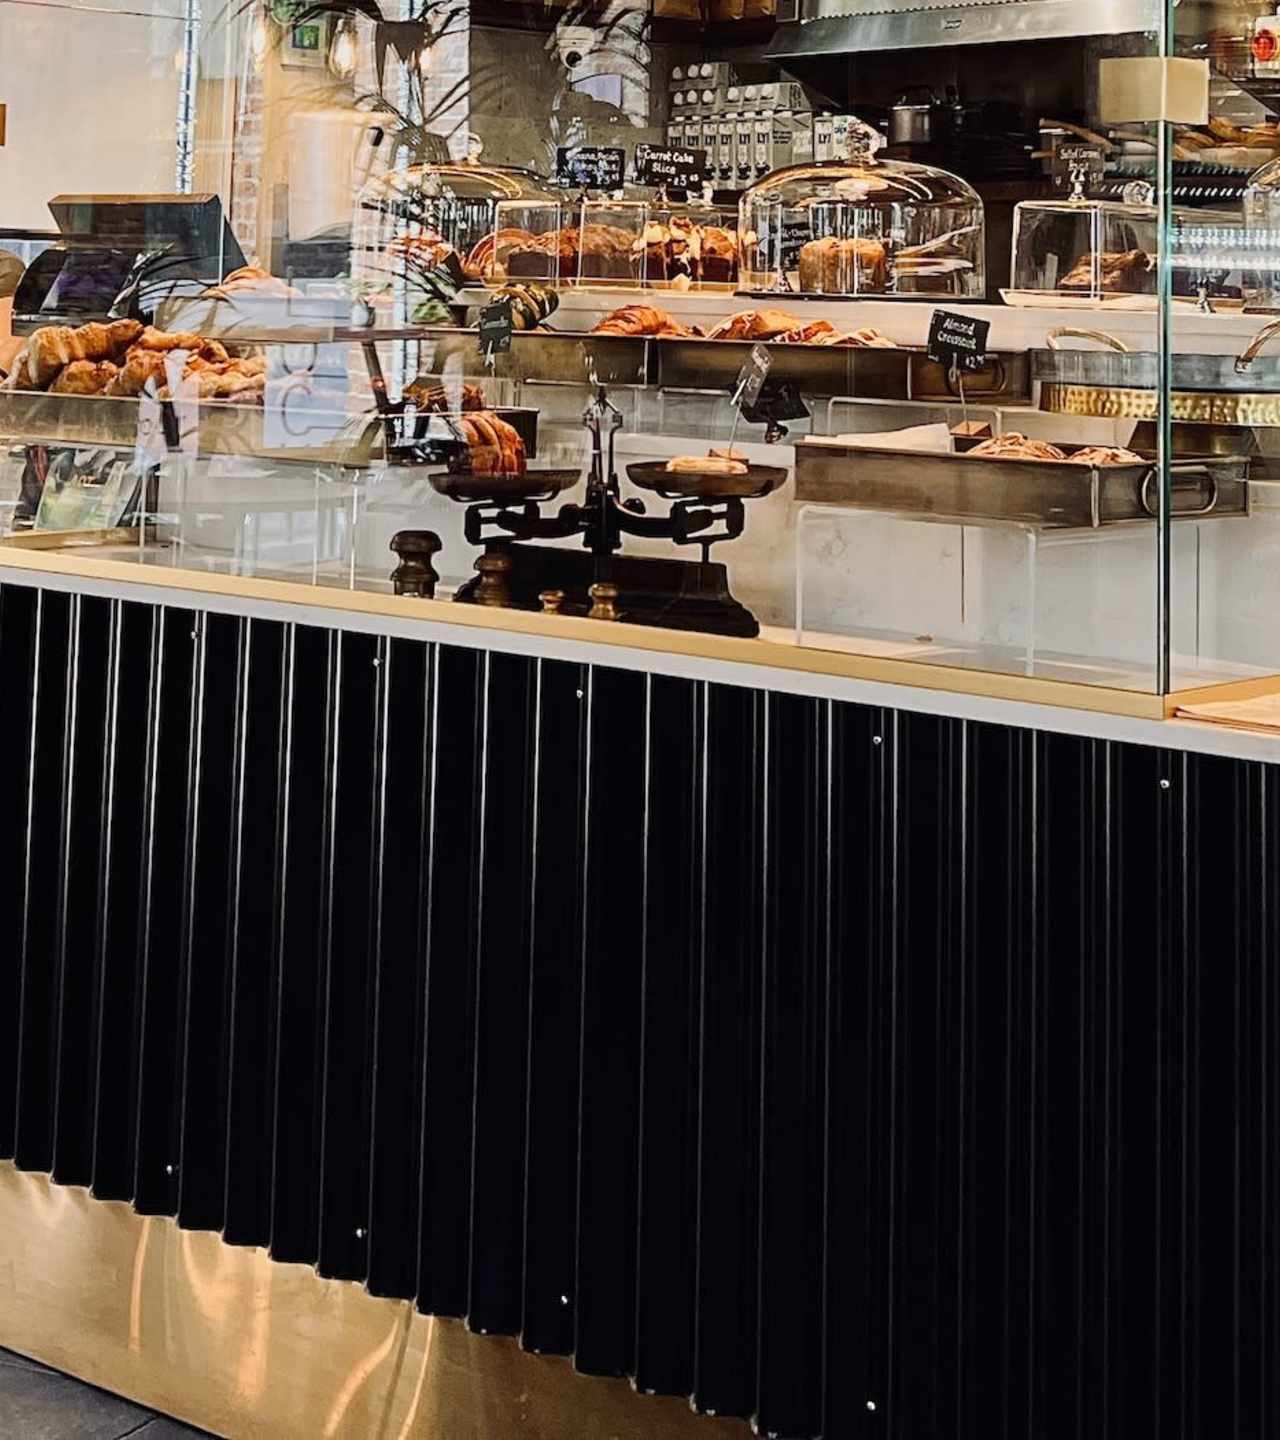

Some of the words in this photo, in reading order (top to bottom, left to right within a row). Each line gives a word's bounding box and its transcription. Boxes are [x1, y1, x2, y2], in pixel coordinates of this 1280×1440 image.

[645, 150, 671, 161] Carrot
[673, 153, 694, 163] Cake
[652, 164, 676, 174] Slice
[943, 318, 975, 335] Almond
